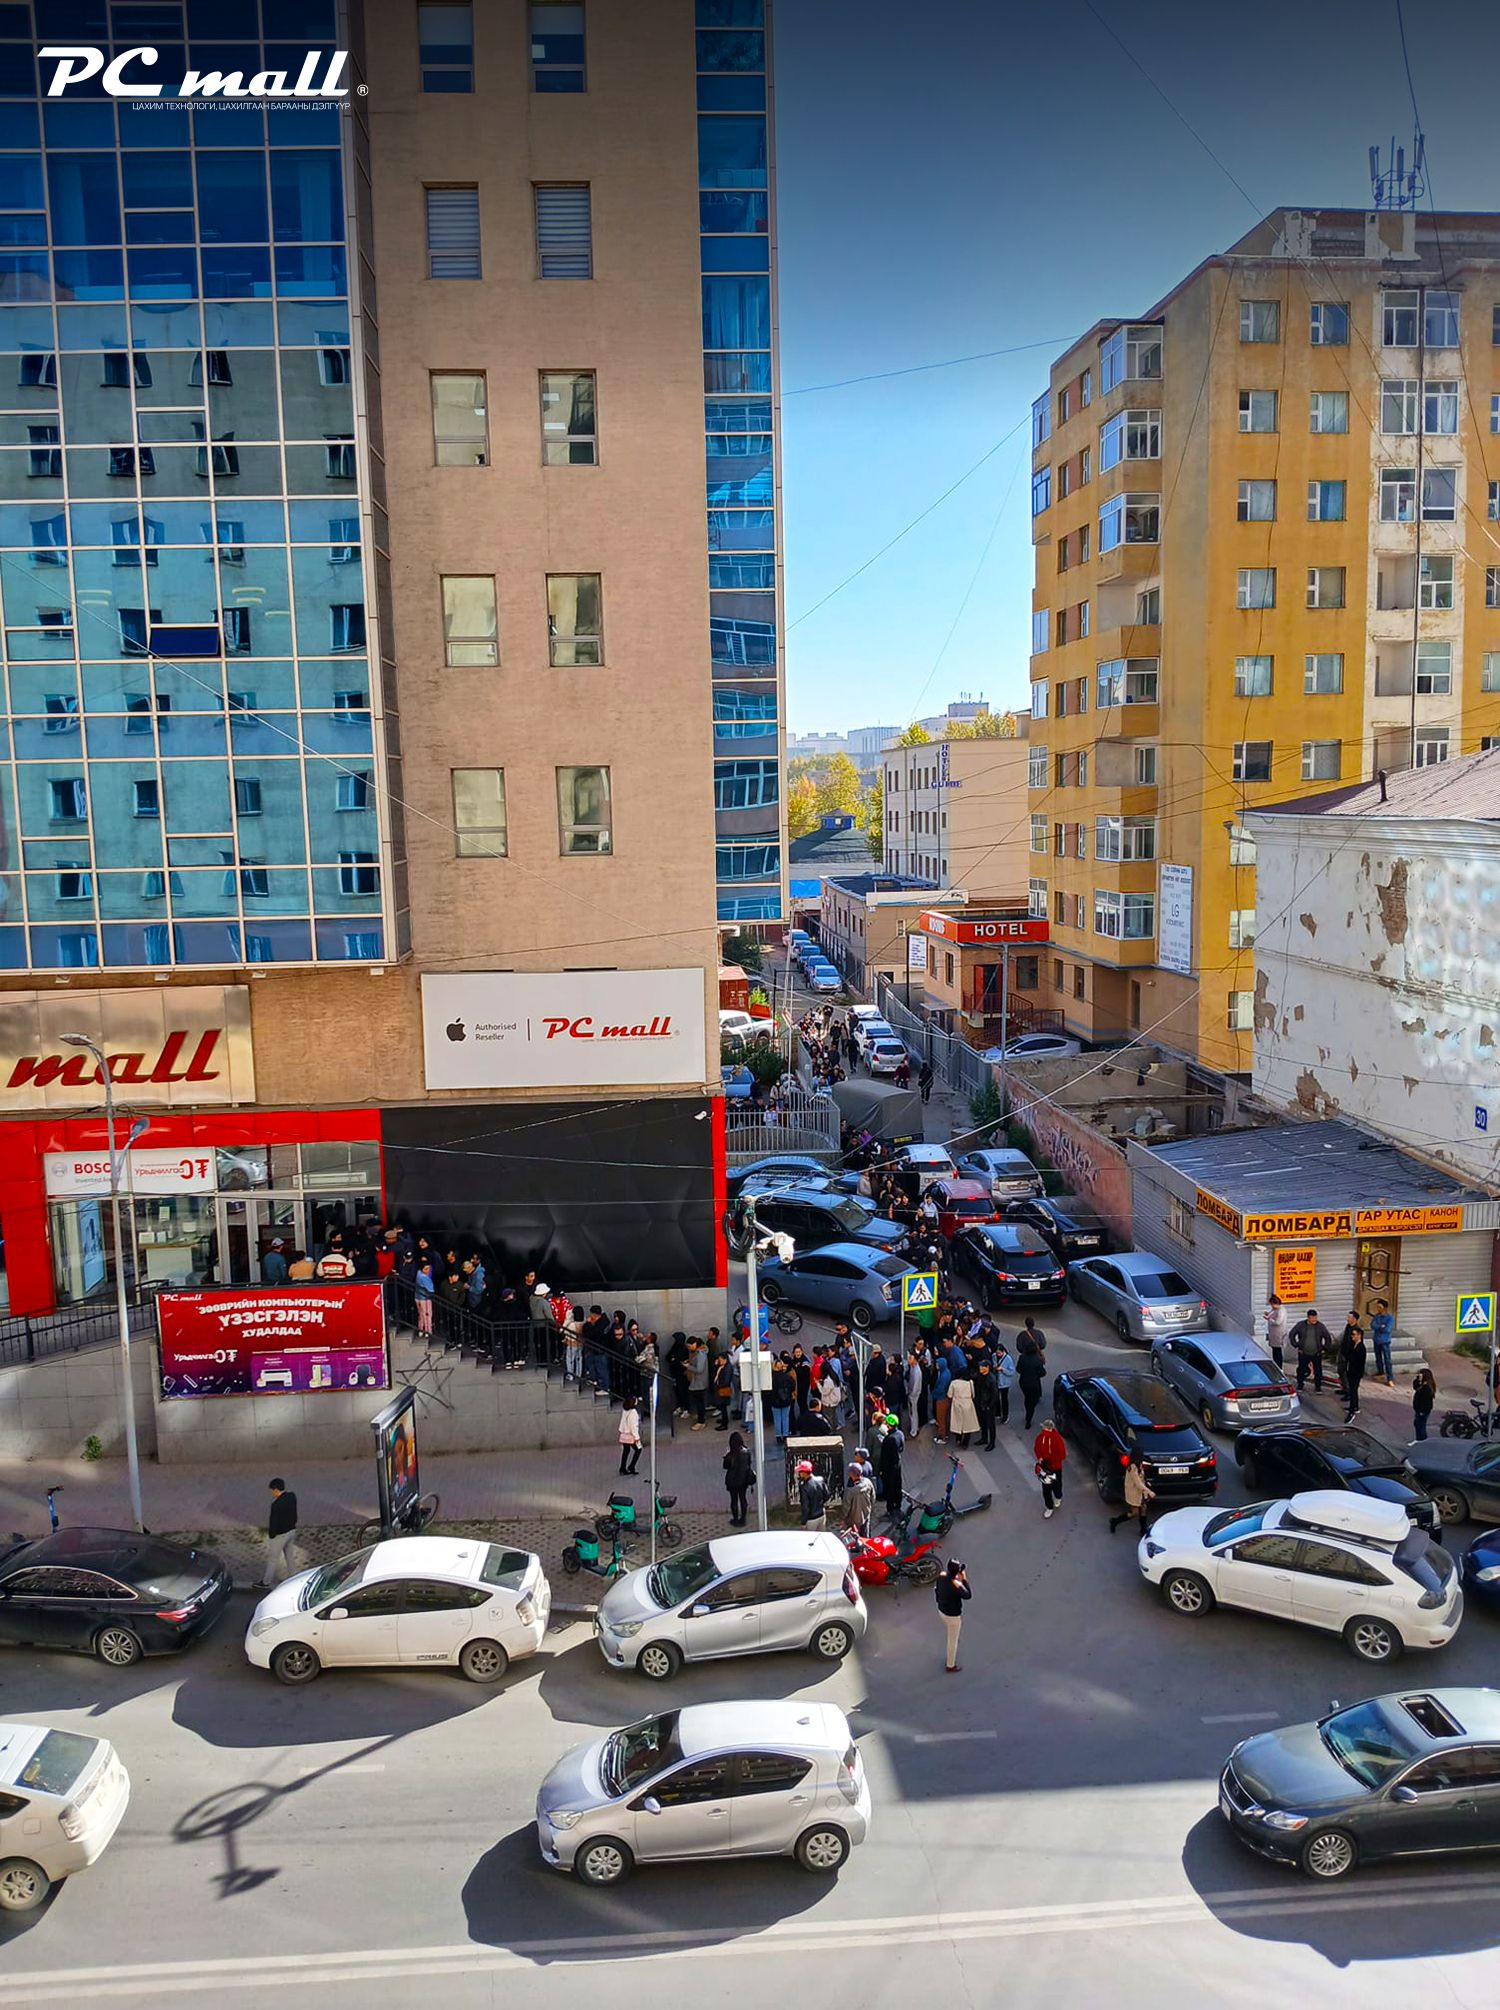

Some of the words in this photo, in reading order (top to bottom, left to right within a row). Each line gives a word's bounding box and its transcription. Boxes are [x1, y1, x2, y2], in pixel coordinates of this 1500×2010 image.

[974, 923, 1028, 937] HOTEL
[475, 1022, 517, 1032] Authorised
[542, 1016, 595, 1039] PC
[601, 1016, 672, 1037] mall
[475, 1033, 505, 1041] Reseller
[7, 1028, 222, 1088] mall
[74, 1162, 115, 1175] BOSC
[1197, 1191, 1240, 1234] ЛОМБАРД
[1357, 1210, 1382, 1221] ГАР
[1386, 1209, 1421, 1221] УТАС
[1429, 1207, 1458, 1217] КАНОН
[1246, 1215, 1352, 1233] ЛОМБАРД
[162, 1294, 179, 1302] PC
[218, 1309, 324, 1327] ҮЗЭСГЭЛЭН
[241, 1326, 302, 1338] ХУДАЛДАА
